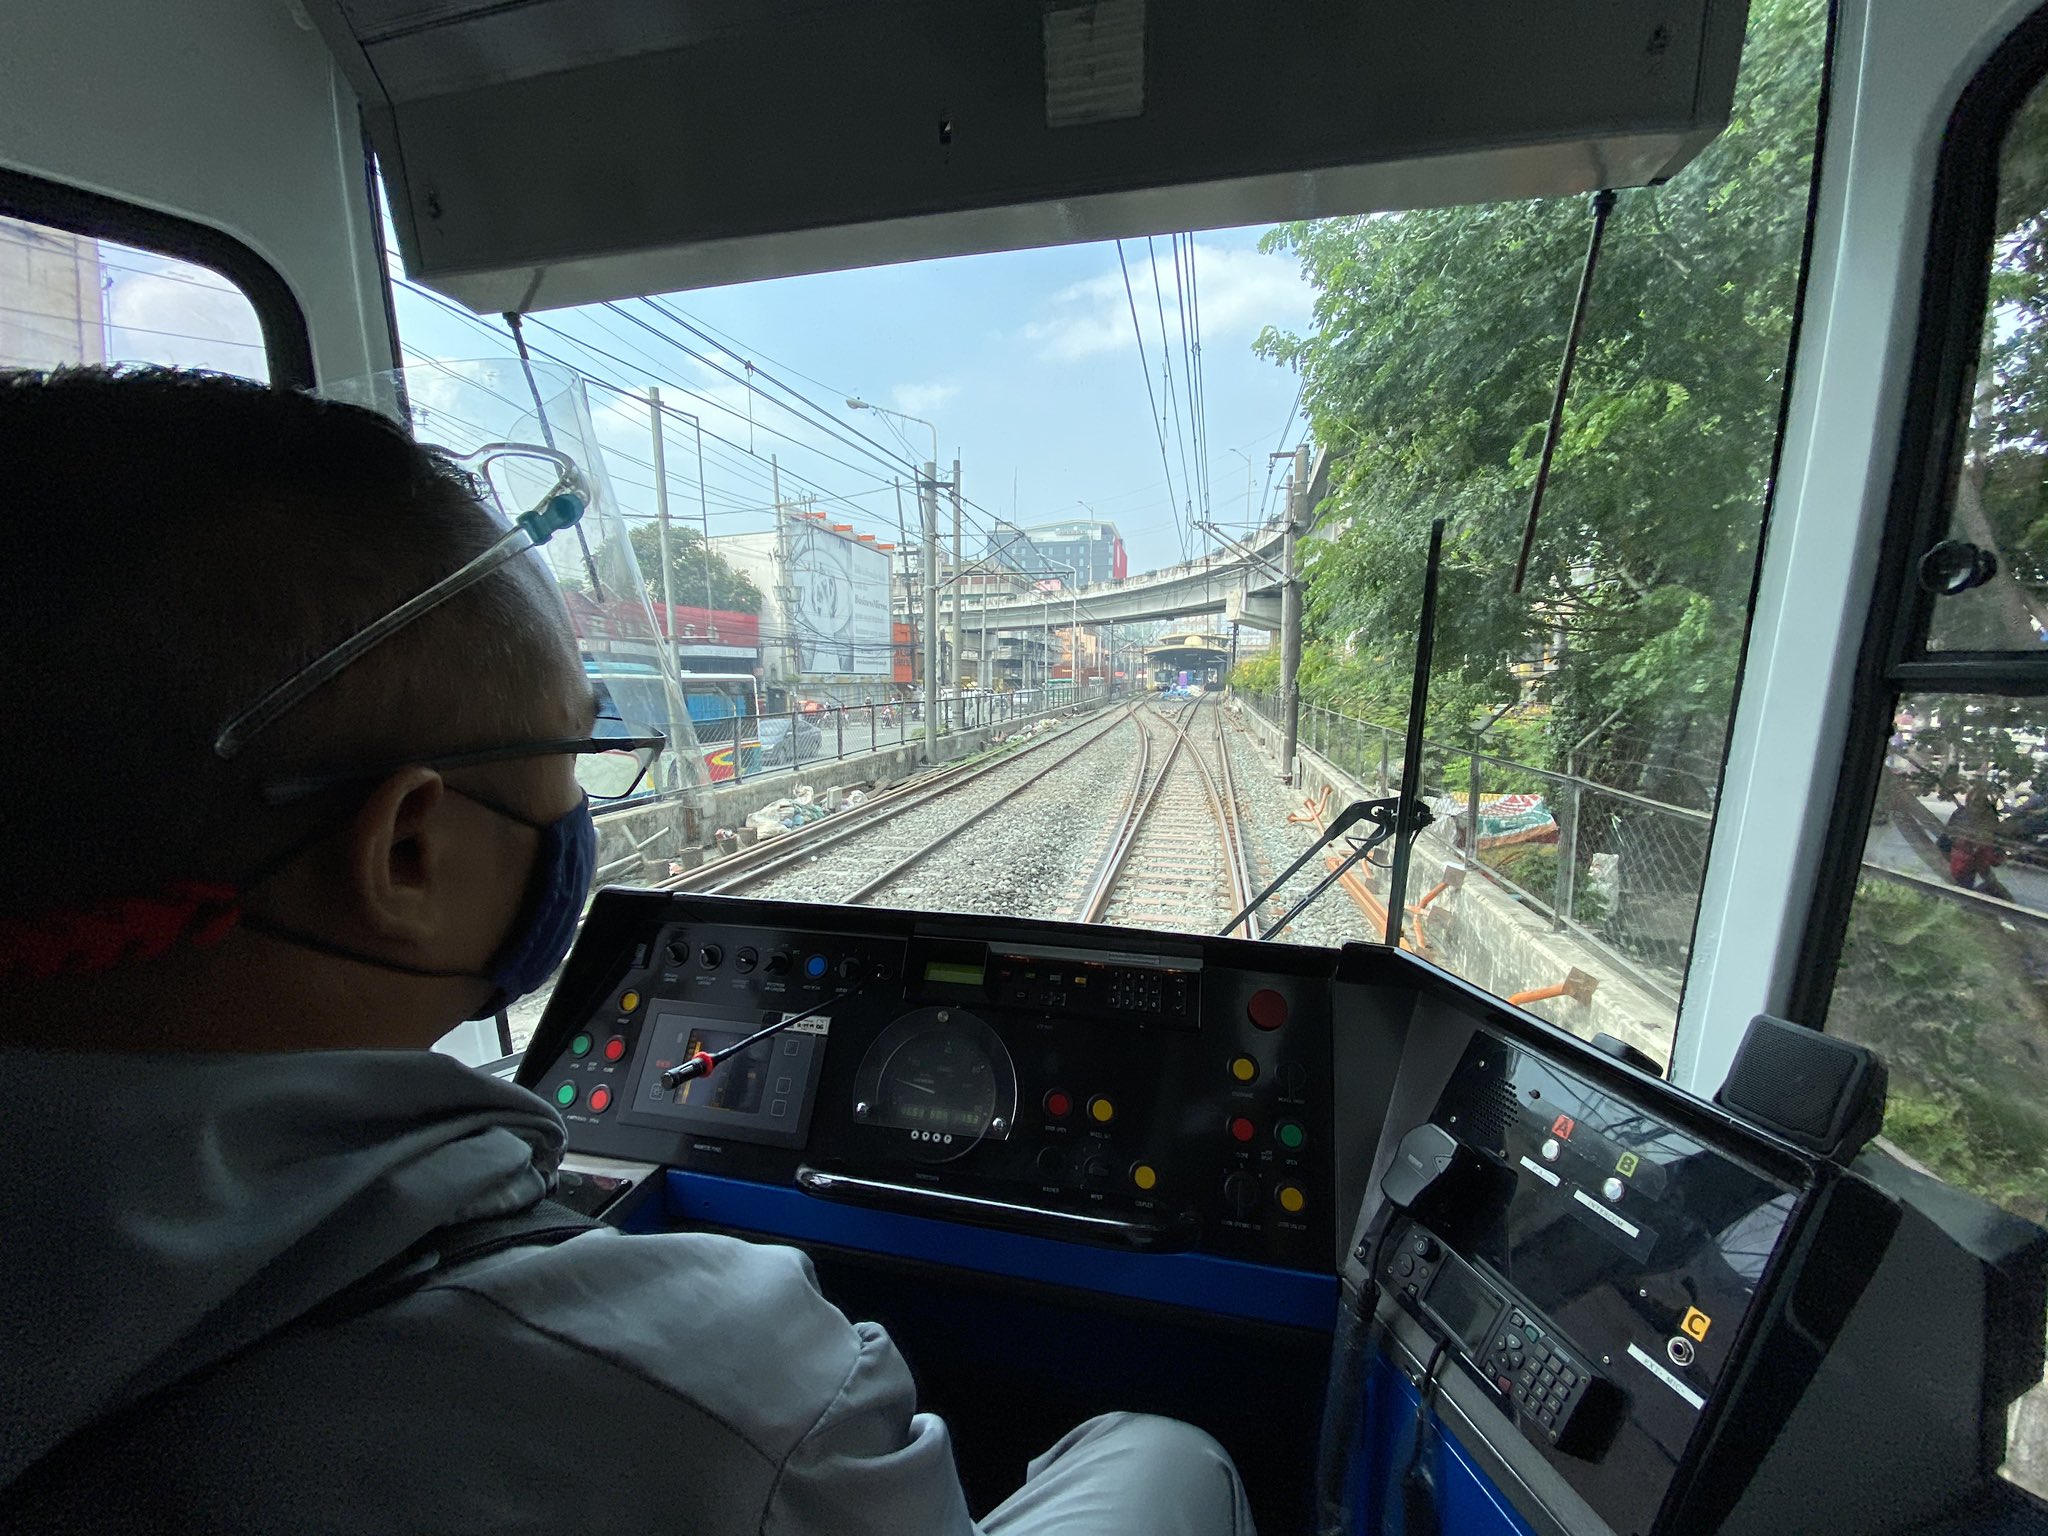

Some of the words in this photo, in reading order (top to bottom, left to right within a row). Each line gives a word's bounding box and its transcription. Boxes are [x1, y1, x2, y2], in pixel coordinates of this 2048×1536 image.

[1554, 1118, 1569, 1138] A
[1618, 1155, 1636, 1173] B
[1588, 1200, 1623, 1226] INTERCOM
[1687, 1313, 1706, 1336] C
